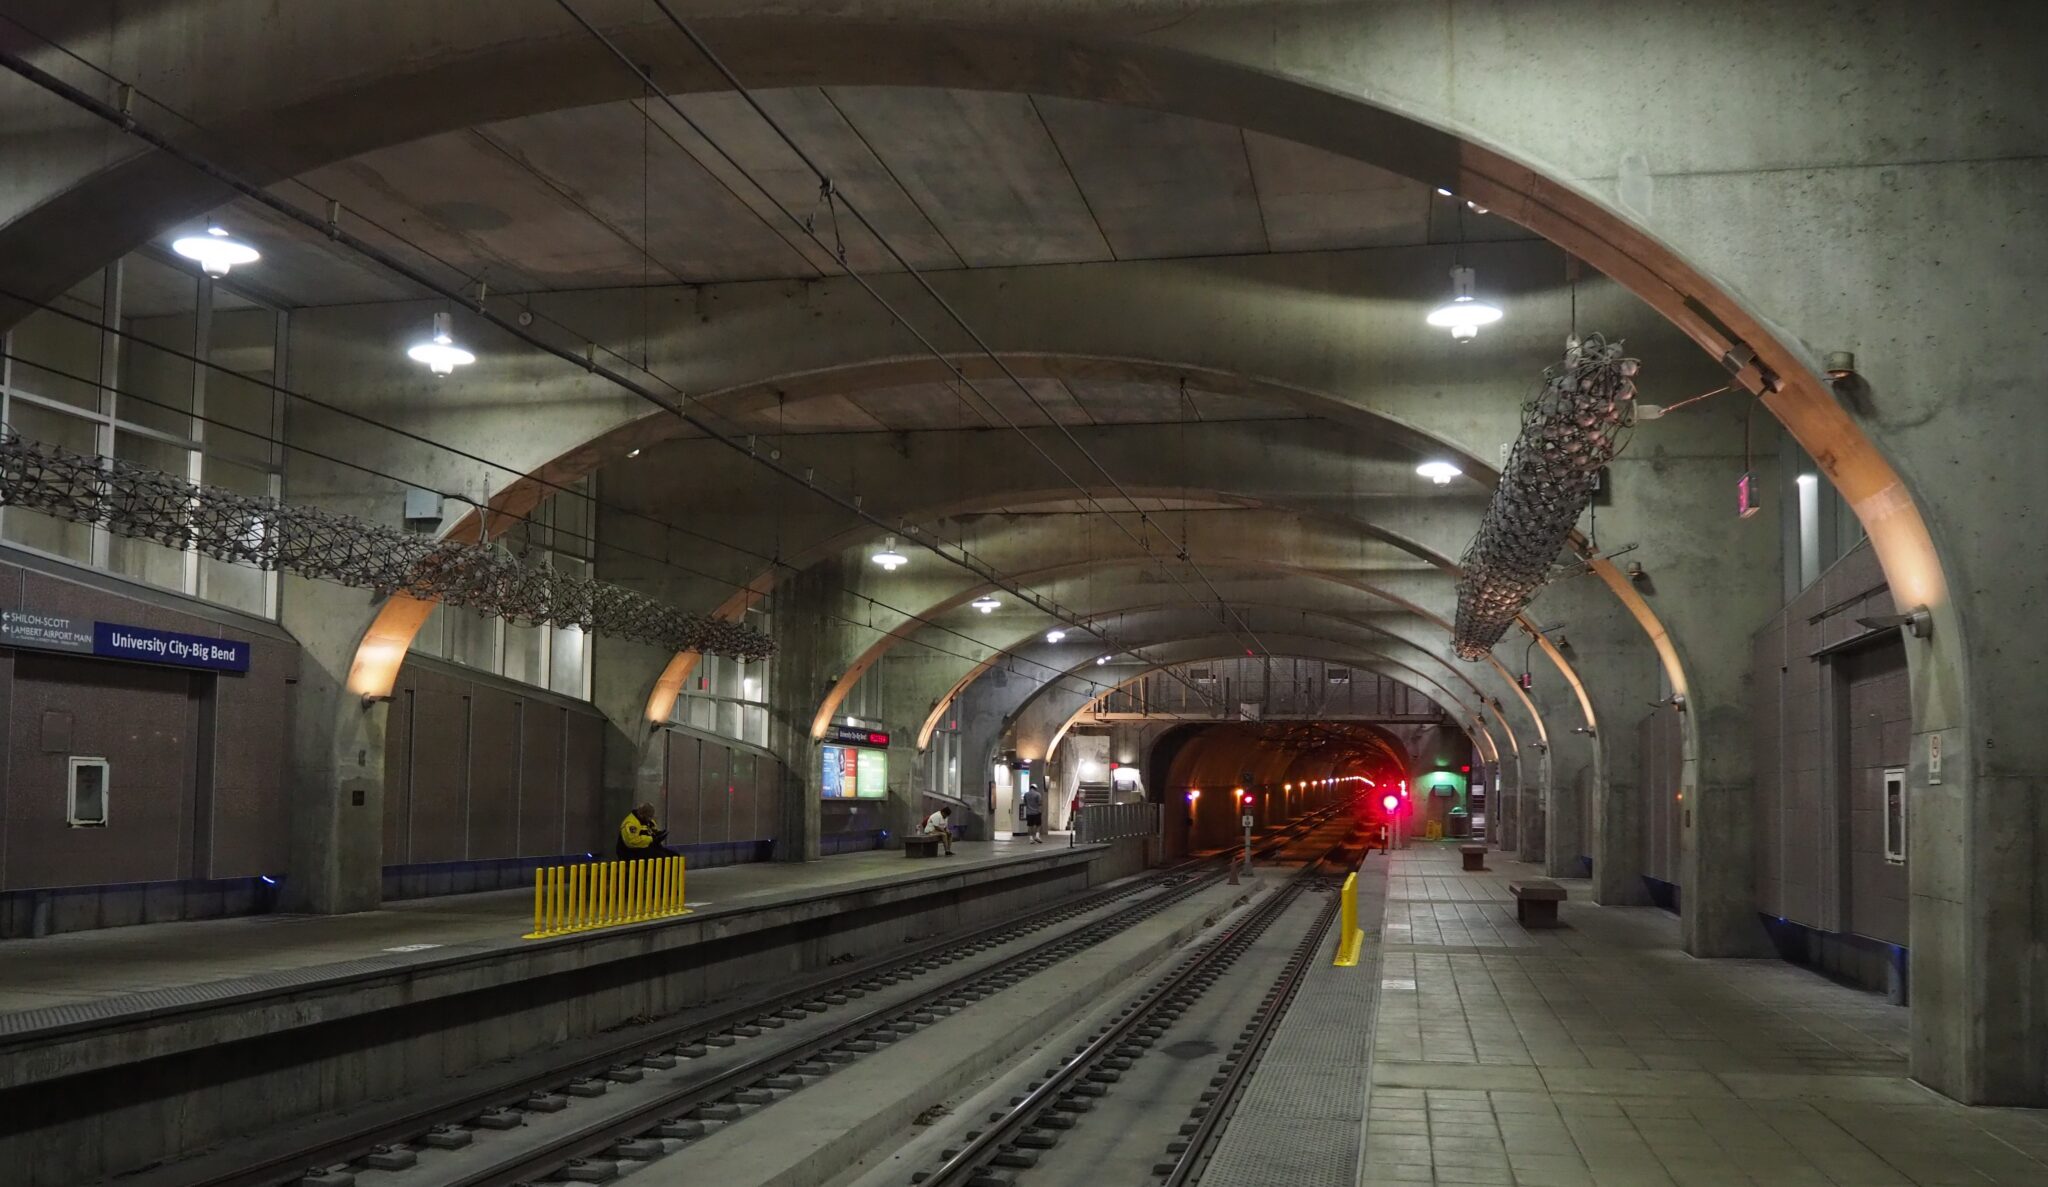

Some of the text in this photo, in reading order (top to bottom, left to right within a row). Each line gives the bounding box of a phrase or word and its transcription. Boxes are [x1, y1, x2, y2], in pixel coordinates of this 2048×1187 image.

[11, 612, 70, 629] SHILOH-SCOTT
[10, 625, 42, 637] LAMBERT
[43, 630, 72, 641] AIRPORT
[73, 633, 92, 643] MAIN
[112, 632, 235, 661] University City-Big Bend
